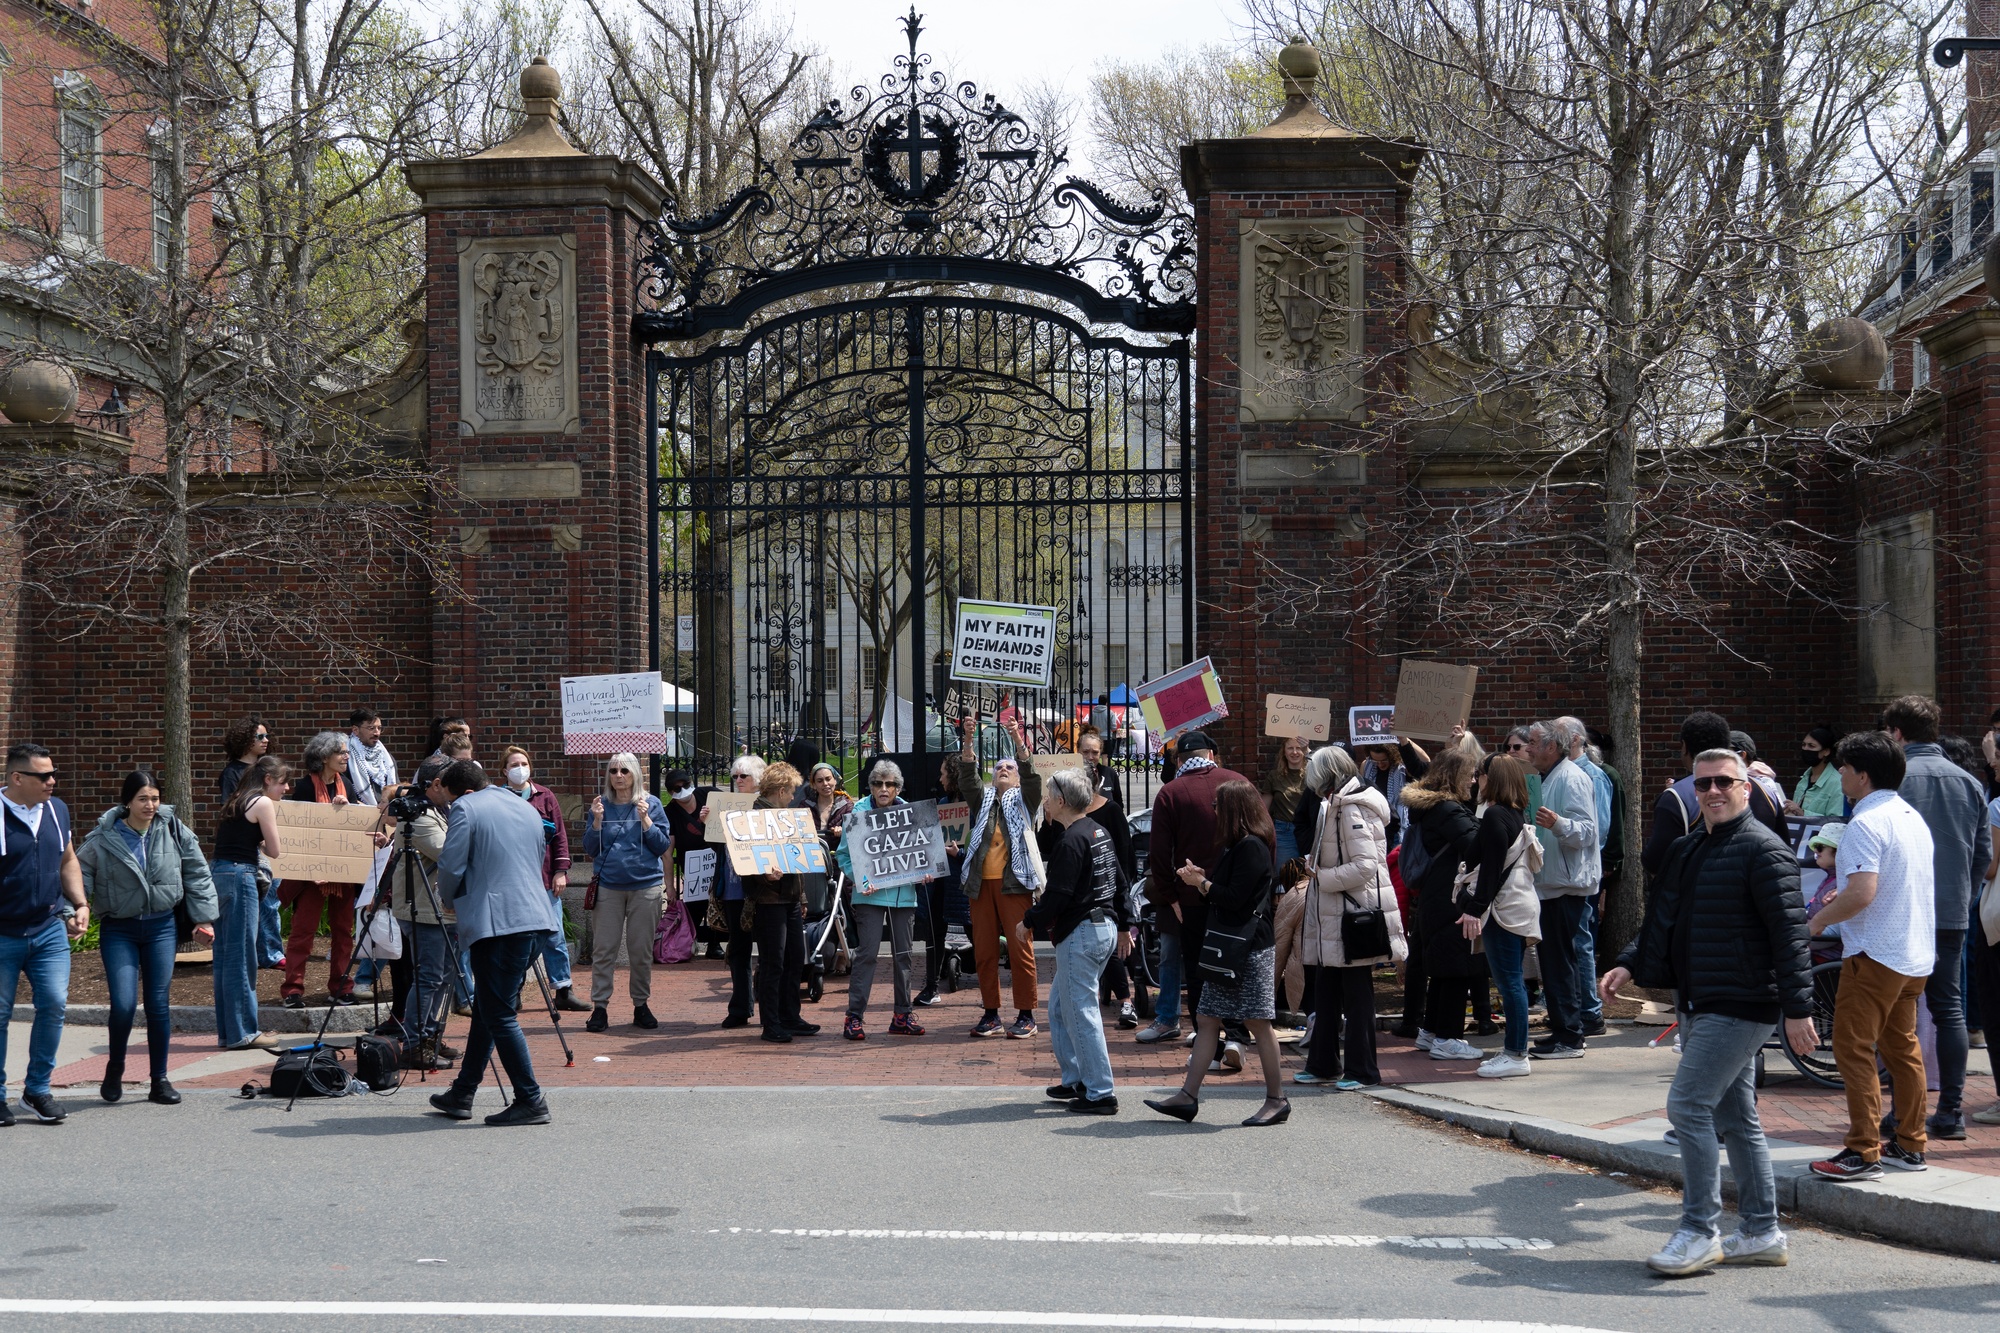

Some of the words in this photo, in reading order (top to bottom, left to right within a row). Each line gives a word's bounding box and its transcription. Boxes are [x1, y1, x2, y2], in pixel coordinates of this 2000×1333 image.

[480, 386, 561, 398] REIPBLICAE
[965, 619, 992, 633] MY
[996, 621, 1045, 639] FAITH
[963, 637, 1045, 657] DEMANDS
[961, 655, 1042, 675] CEASEFIRE
[1400, 670, 1457, 690] CAMBRIDGE
[565, 685, 615, 704] Harvard
[618, 682, 654, 698] Divest
[948, 688, 996, 713] LIERAED
[1397, 686, 1442, 706] STANDS
[1275, 698, 1318, 711] Ceasefire
[1289, 715, 1312, 725] Now
[276, 805, 329, 825] Another
[338, 808, 370, 827] Jew
[869, 807, 913, 832] LET
[938, 806, 969, 820] SEFIRE
[726, 810, 815, 841] CEASE
[941, 823, 965, 843] OW
[335, 833, 364, 854] the
[863, 828, 930, 855] GAZA
[279, 857, 350, 879] occupation
[751, 843, 826, 874] FIRE
[872, 850, 929, 876] LIVE
